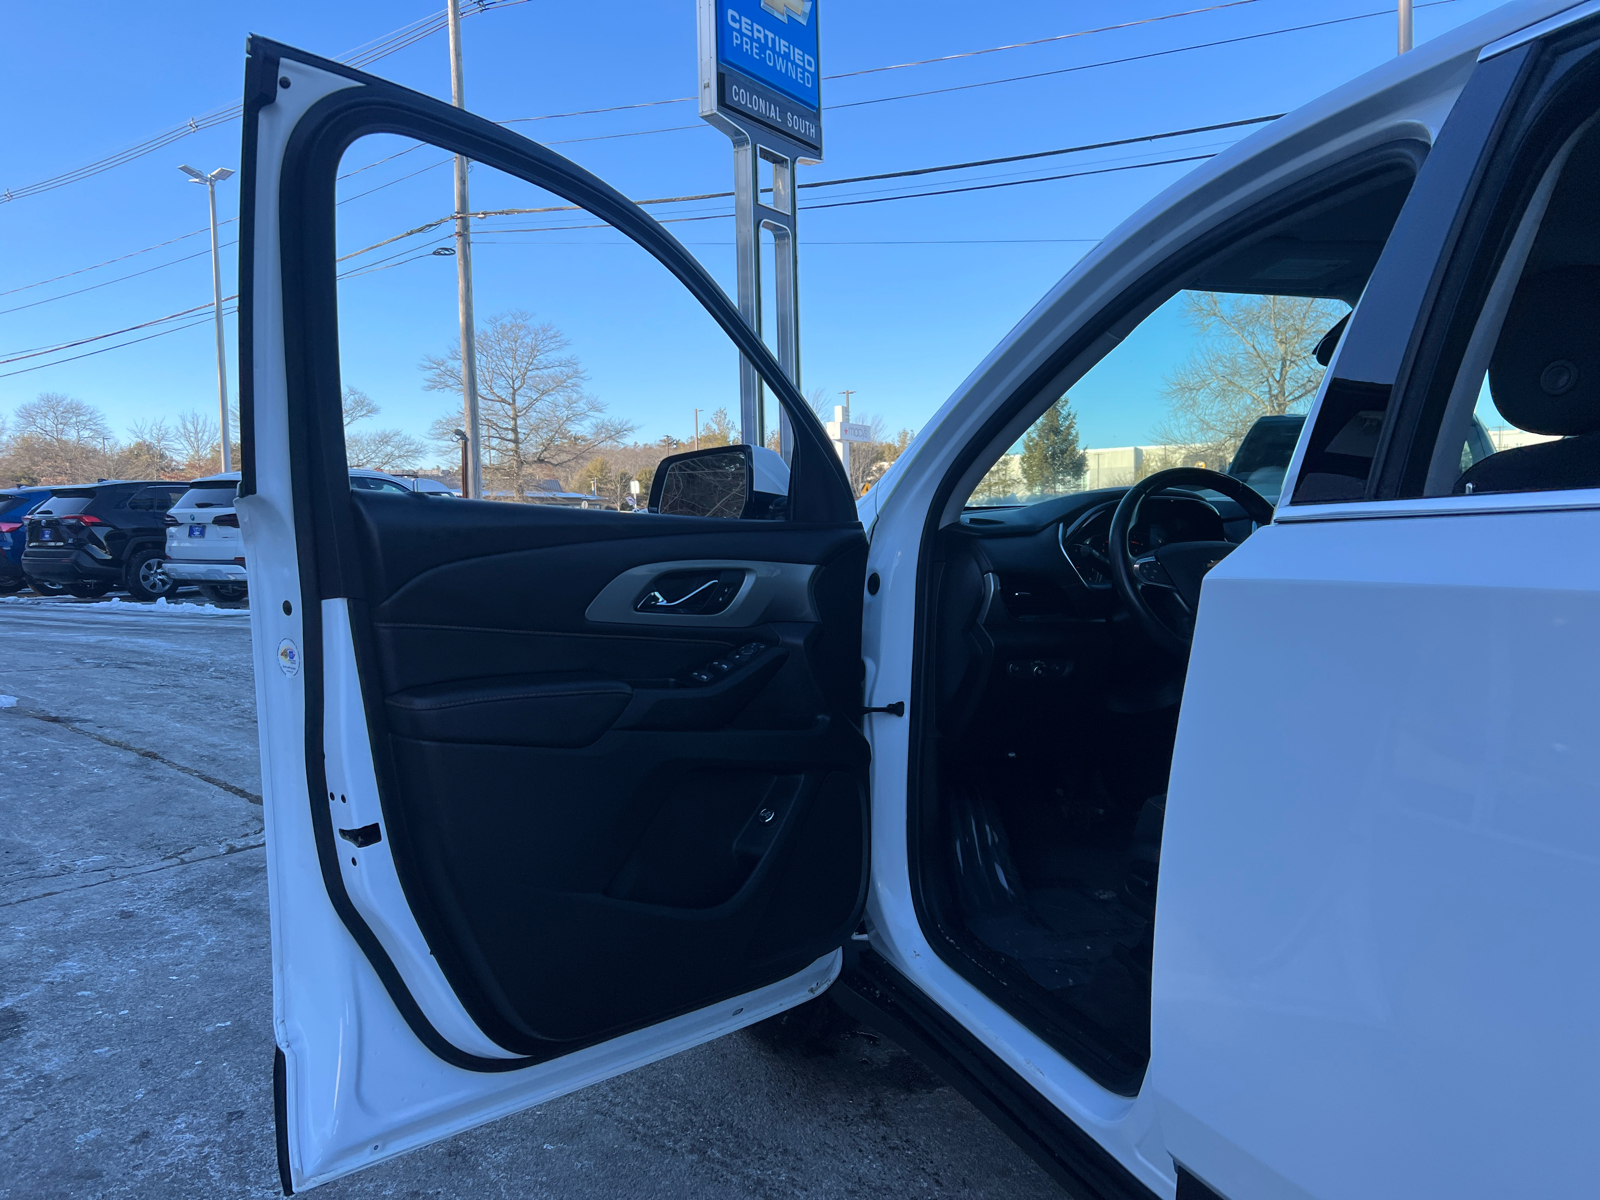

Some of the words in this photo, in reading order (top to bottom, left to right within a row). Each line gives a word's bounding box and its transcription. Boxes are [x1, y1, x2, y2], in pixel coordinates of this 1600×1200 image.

[727, 8, 815, 73] CERTIFIED
[732, 31, 812, 88] PRE-OWNED
[732, 85, 782, 122] COLONIAL
[787, 112, 816, 139] SOUTH
